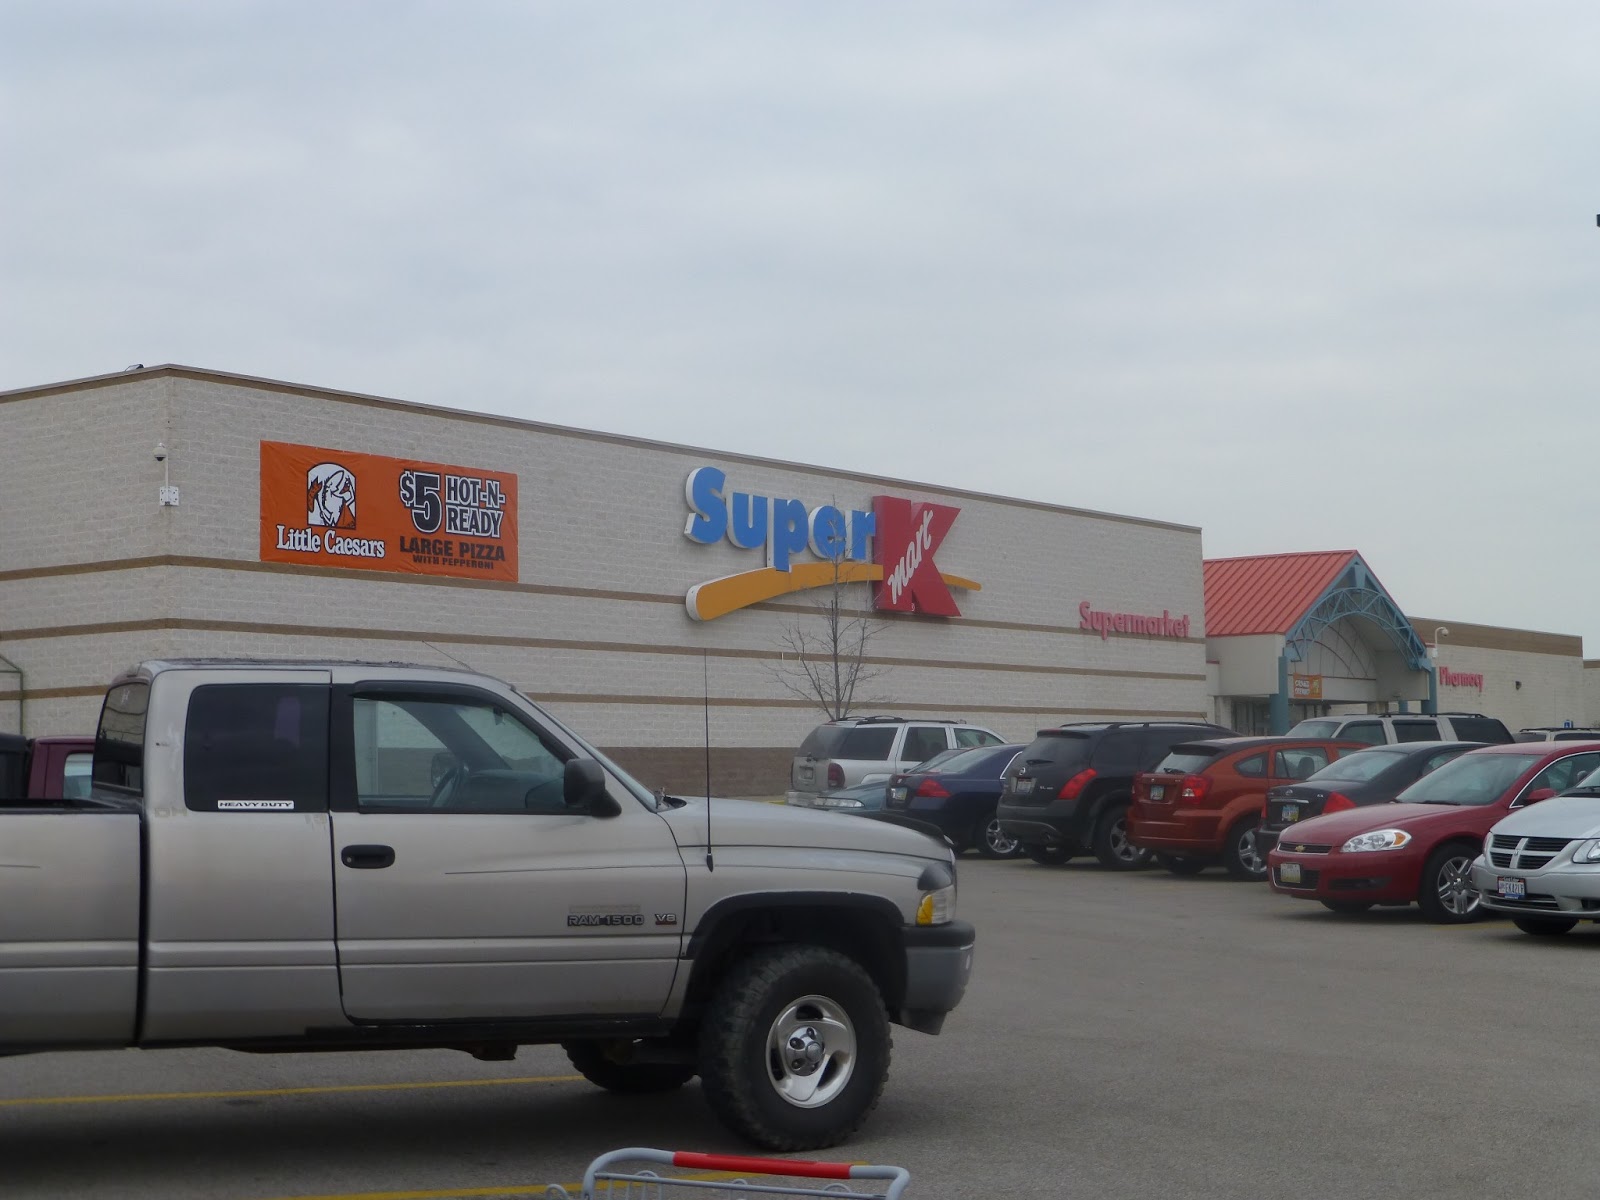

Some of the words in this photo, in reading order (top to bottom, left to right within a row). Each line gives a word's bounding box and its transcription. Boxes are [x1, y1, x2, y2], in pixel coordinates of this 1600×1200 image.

[400, 470, 442, 533] $5
[445, 474, 506, 509] HOT-N-
[445, 504, 503, 538] READY
[684, 466, 876, 572] Super
[276, 525, 321, 553] Little
[324, 529, 385, 558] Caesars
[400, 536, 453, 557] LARGE
[459, 541, 505, 562] PIZZA
[873, 495, 961, 617] K
[888, 510, 933, 604] mart
[412, 554, 440, 565] WITH
[442, 557, 494, 570] PEPPERONI
[1079, 601, 1190, 640] Supermarket
[1439, 666, 1484, 692] Pharmacy
[567, 915, 600, 927] RAM
[605, 914, 645, 926] 1500
[655, 913, 678, 922] V8
